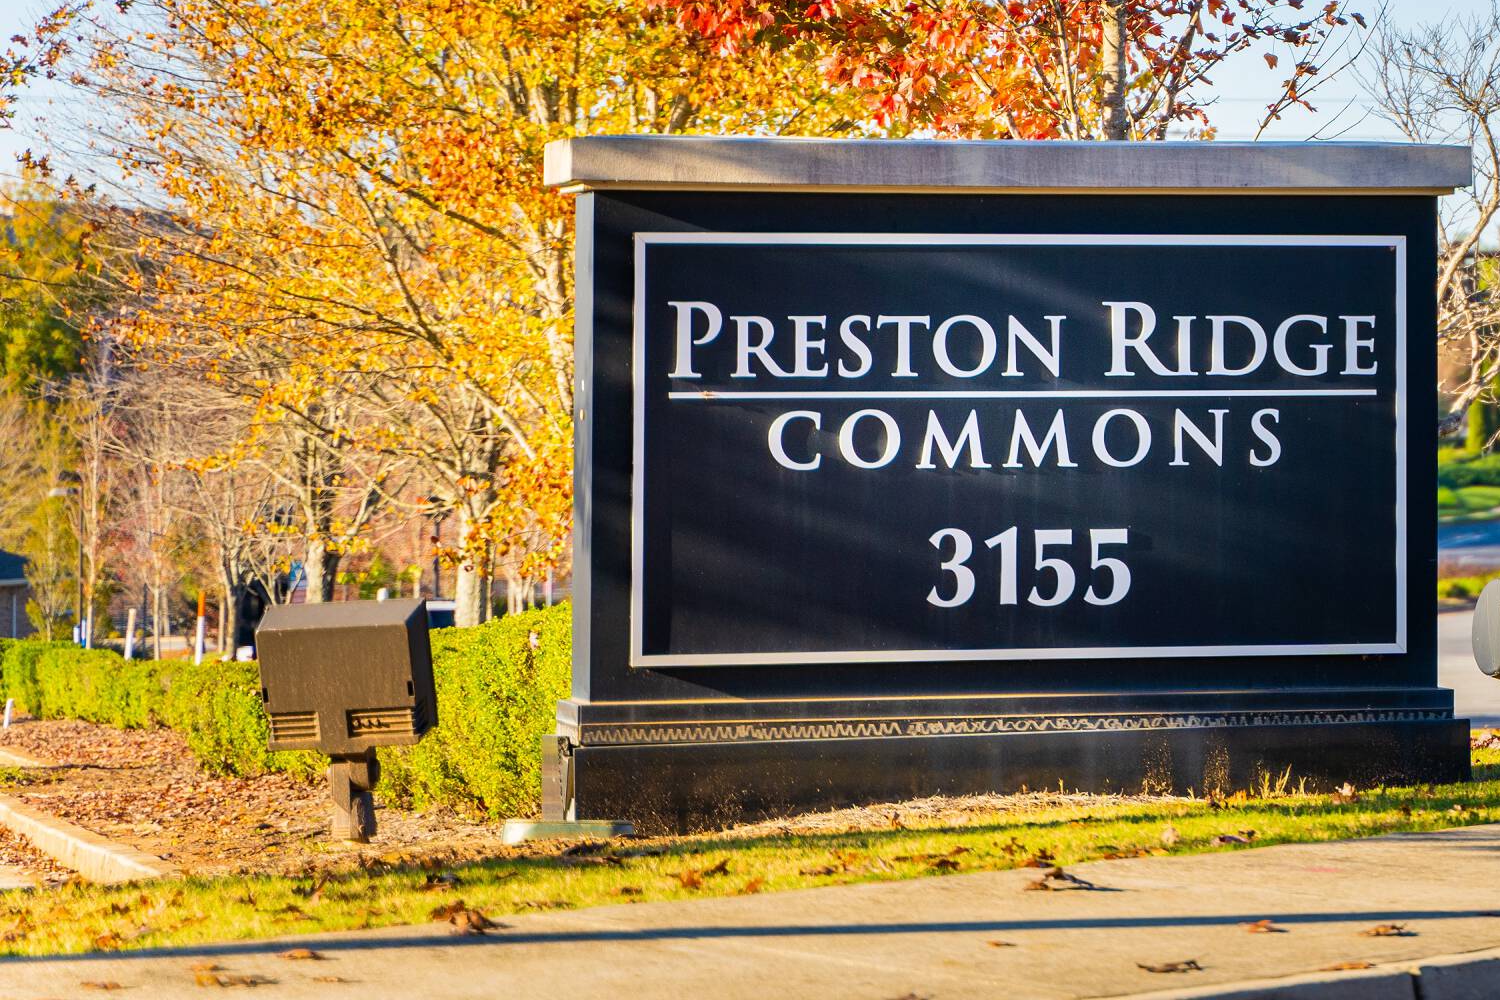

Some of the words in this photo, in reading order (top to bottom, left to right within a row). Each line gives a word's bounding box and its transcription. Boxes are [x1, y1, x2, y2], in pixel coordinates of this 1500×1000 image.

[667, 301, 1067, 378] PRESTON
[1101, 301, 1378, 377] RIDGE
[767, 408, 1281, 471] COMMONS
[926, 525, 1131, 608] 3155
